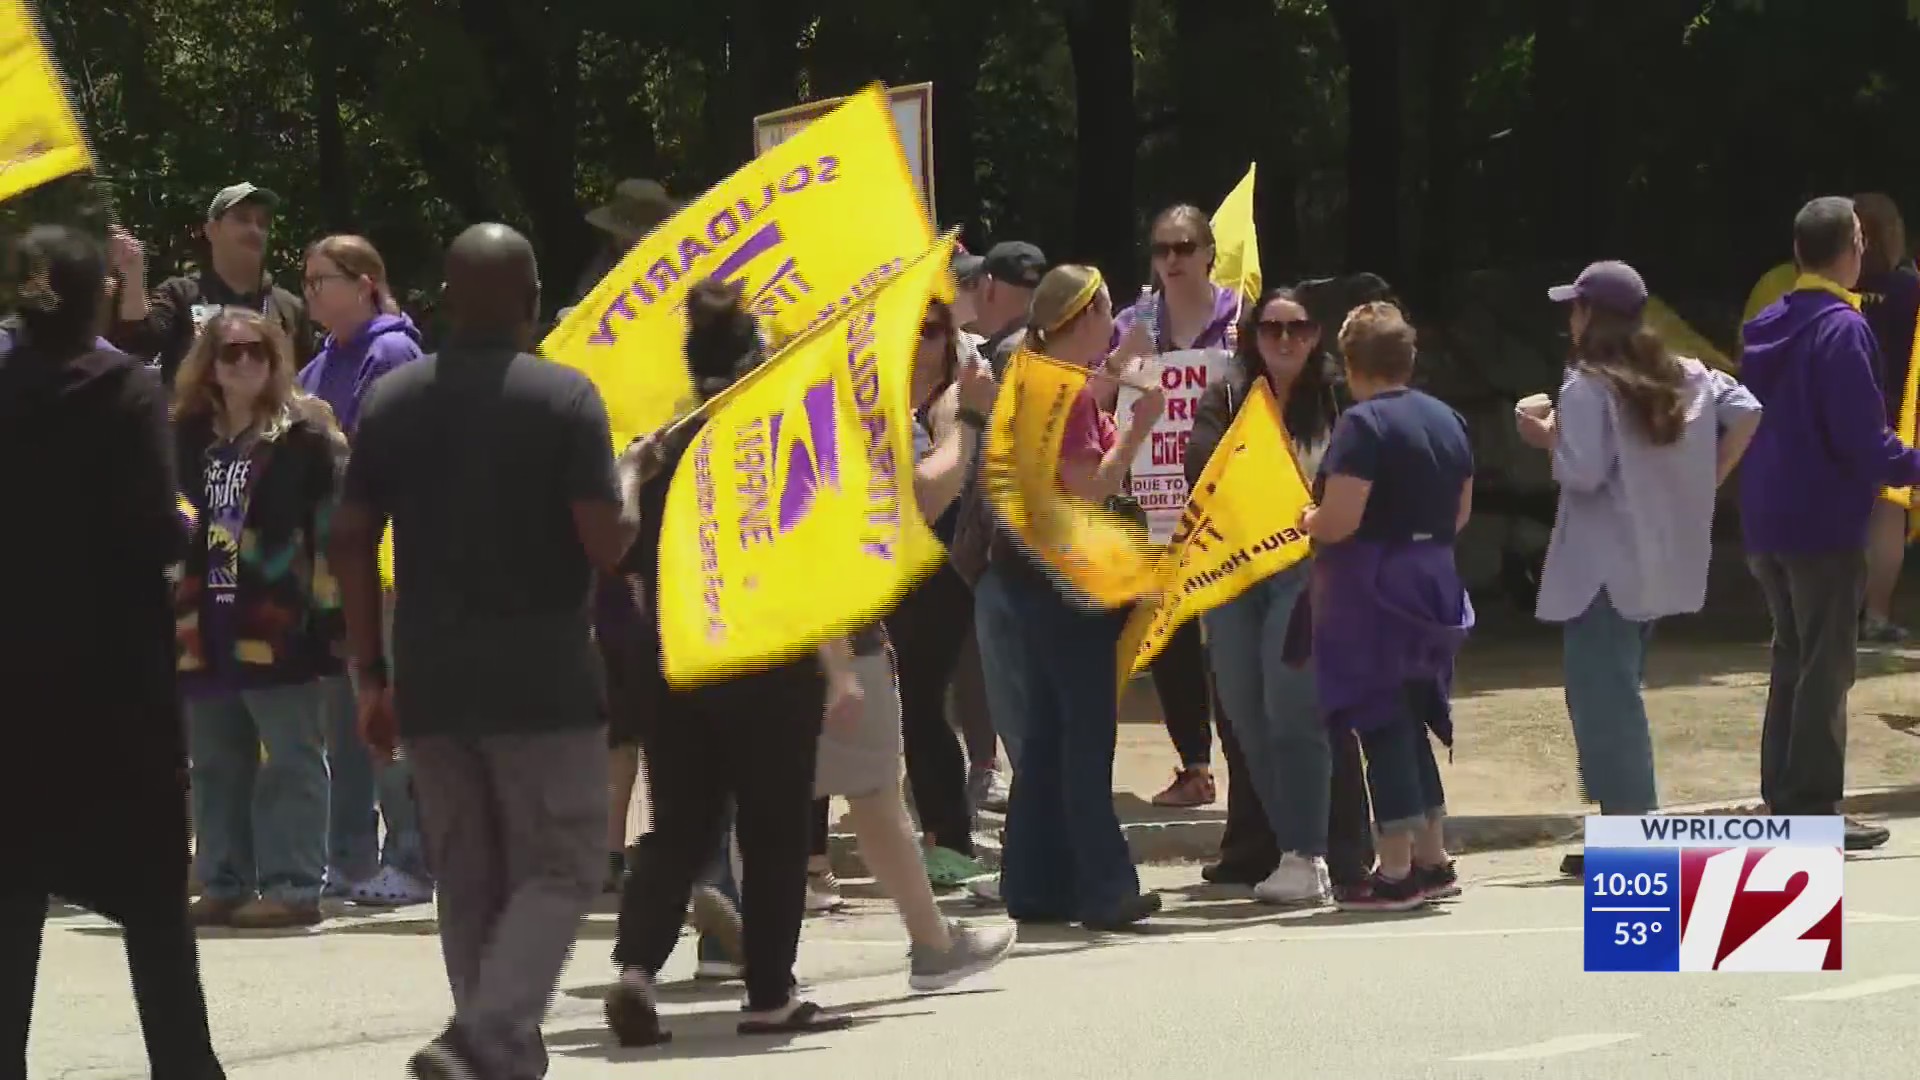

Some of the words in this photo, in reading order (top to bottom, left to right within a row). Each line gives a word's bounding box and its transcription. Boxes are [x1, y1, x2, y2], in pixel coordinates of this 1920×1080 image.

[1161, 365, 1207, 389] ON
[734, 417, 774, 549] 1199NE
[1134, 478, 1160, 491] DUE
[1165, 478, 1184, 490] TO
